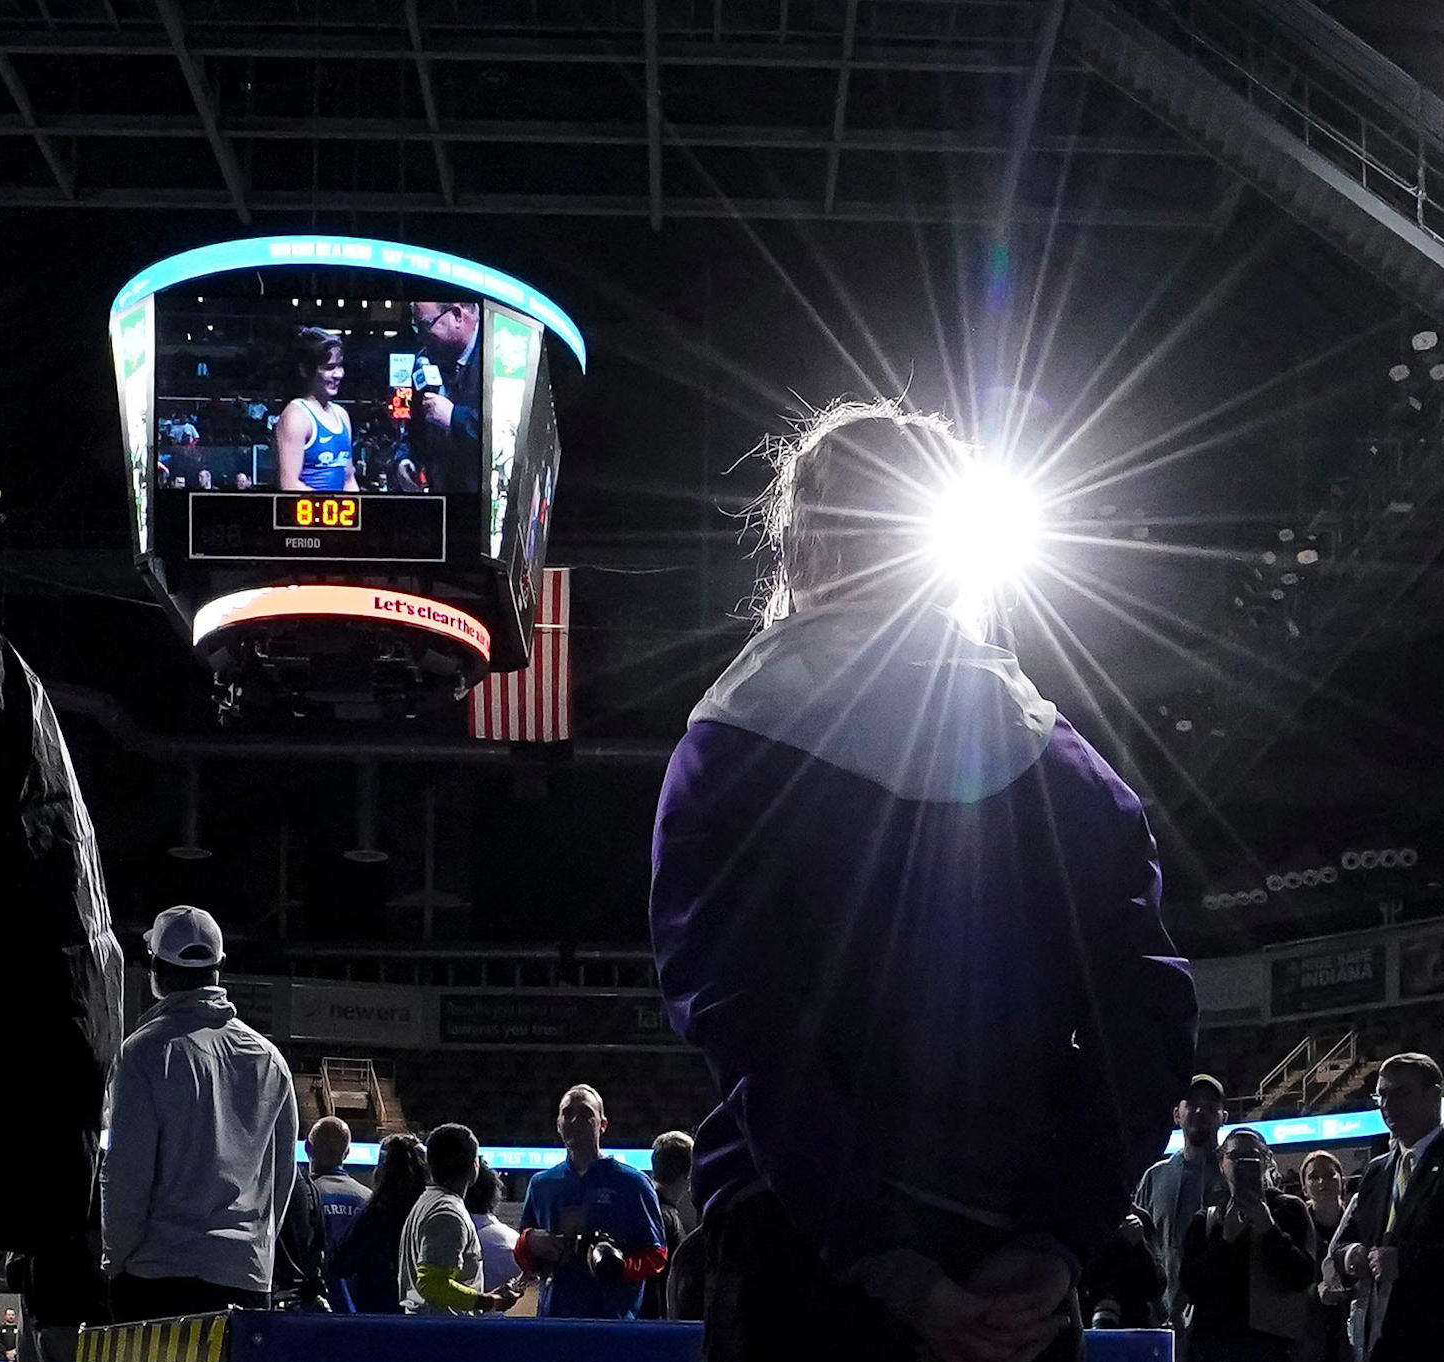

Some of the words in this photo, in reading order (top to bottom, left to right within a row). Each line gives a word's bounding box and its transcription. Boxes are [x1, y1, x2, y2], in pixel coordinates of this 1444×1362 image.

[295, 499, 356, 526] 8:02
[285, 537, 321, 549] PERIOD
[373, 596, 416, 616] Let's
[416, 605, 457, 629] clear
[457, 615, 476, 639] the
